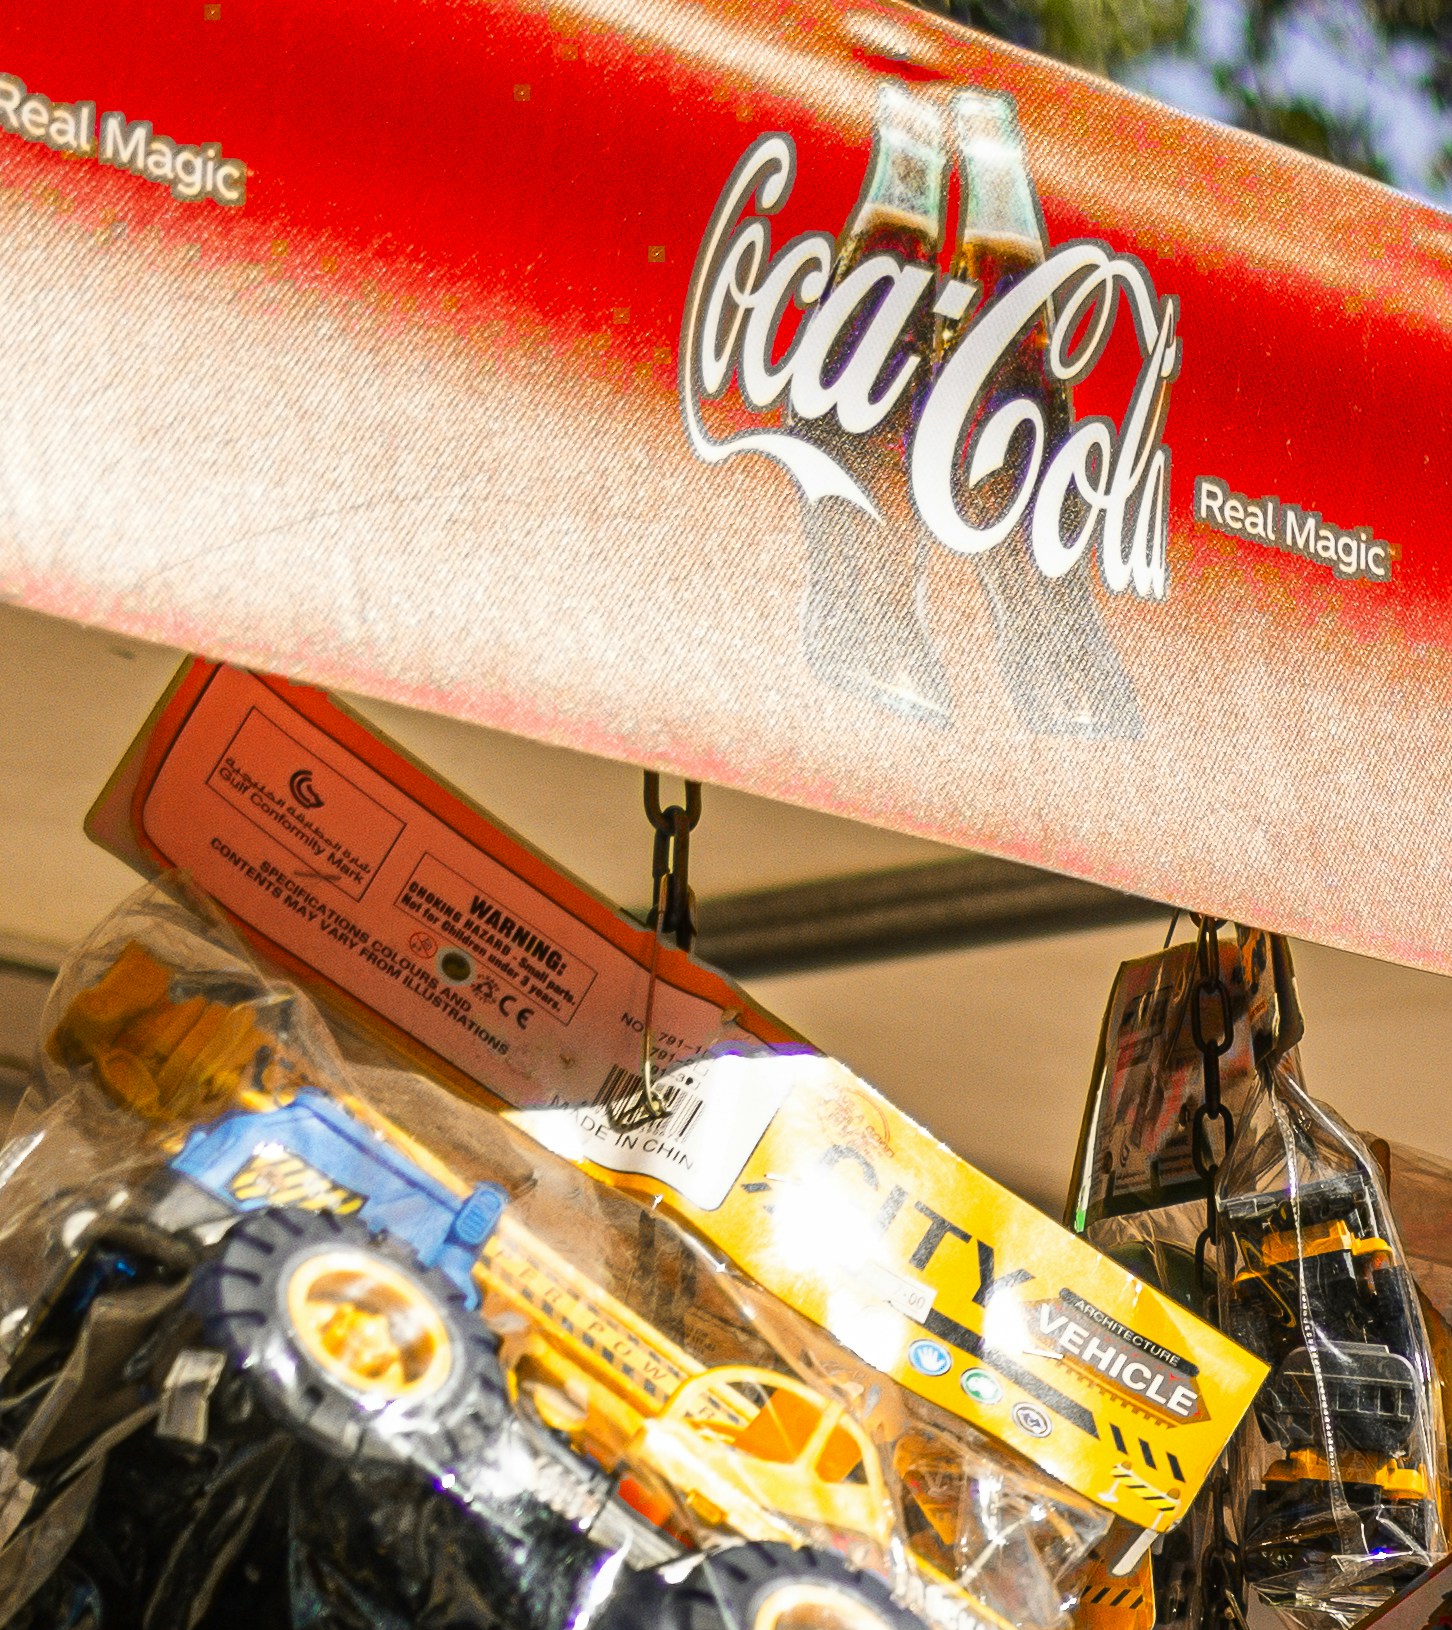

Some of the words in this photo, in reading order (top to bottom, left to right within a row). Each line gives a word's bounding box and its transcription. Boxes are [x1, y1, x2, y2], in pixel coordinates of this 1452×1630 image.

[100, 111, 246, 204] Magic
[684, 135, 1178, 600] Coca-Cola
[1197, 478, 1276, 537] Real
[1281, 502, 1391, 579] Magic
[219, 766, 251, 796] Gulf
[250, 792, 326, 857] Conformity
[327, 852, 364, 885] Mark
[210, 837, 284, 898] CONTENTS
[284, 895, 318, 923] MAY
[319, 918, 359, 951] VARY
[358, 946, 402, 982] FROM
[401, 974, 511, 1057] ILLUSTRATIONS
[260, 860, 370, 945] SPECIFICATIONS
[369, 938, 441, 992] COLOURS
[440, 984, 473, 1014] AND
[423, 907, 440, 926] for
[487, 953, 520, 981] under
[464, 918, 512, 957] HAZARD
[518, 956, 549, 984] Small
[469, 895, 568, 977] WARNING:
[1036, 1303, 1199, 1417] VEHICLE
[1074, 1299, 1182, 1368] ARCHITECTURE
